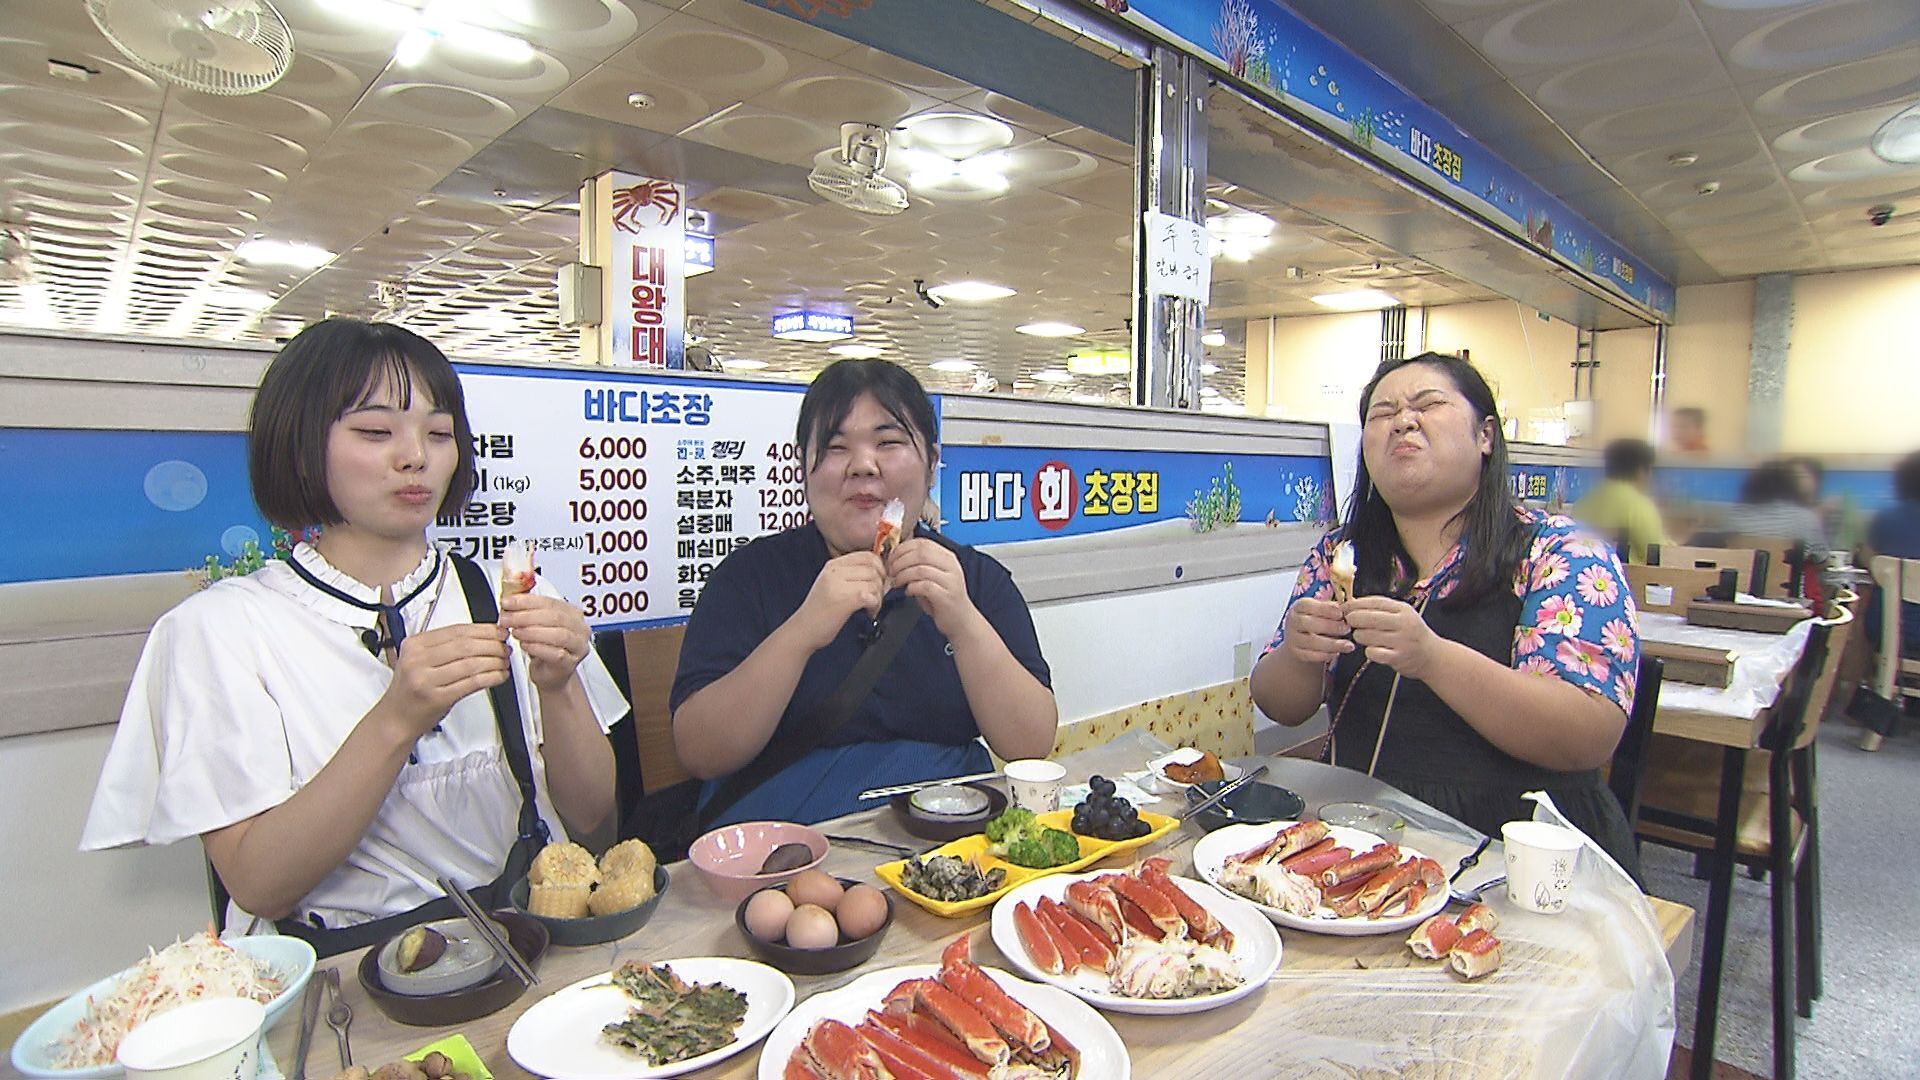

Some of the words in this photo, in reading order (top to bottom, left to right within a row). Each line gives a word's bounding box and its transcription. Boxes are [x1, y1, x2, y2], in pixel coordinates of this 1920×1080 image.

[1410, 127, 1432, 164] 바다
[1433, 142, 1462, 182] 초장집
[631, 245, 666, 370] 대왕대
[584, 389, 713, 426] 바다초장
[471, 434, 514, 459] 차림
[579, 437, 648, 461] 6,000
[711, 440, 746, 460] 켈리
[766, 443, 802, 462] 4,00
[493, 474, 531, 494] (1kg)
[579, 468, 648, 492] 5,000
[676, 465, 756, 486] 소주,맥주
[766, 465, 804, 485] 4,00
[677, 489, 733, 510] 복분자
[758, 489, 805, 509] 12,00
[960, 471, 1027, 522] 바다
[1038, 464, 1071, 521] 회
[1082, 470, 1159, 516] 초장집
[569, 498, 648, 524] 10,000
[677, 514, 733, 535] 설중매
[585, 530, 648, 555] 1,000
[581, 560, 649, 586] 5,000
[581, 591, 649, 618] 3,000
[678, 588, 702, 610] 음
